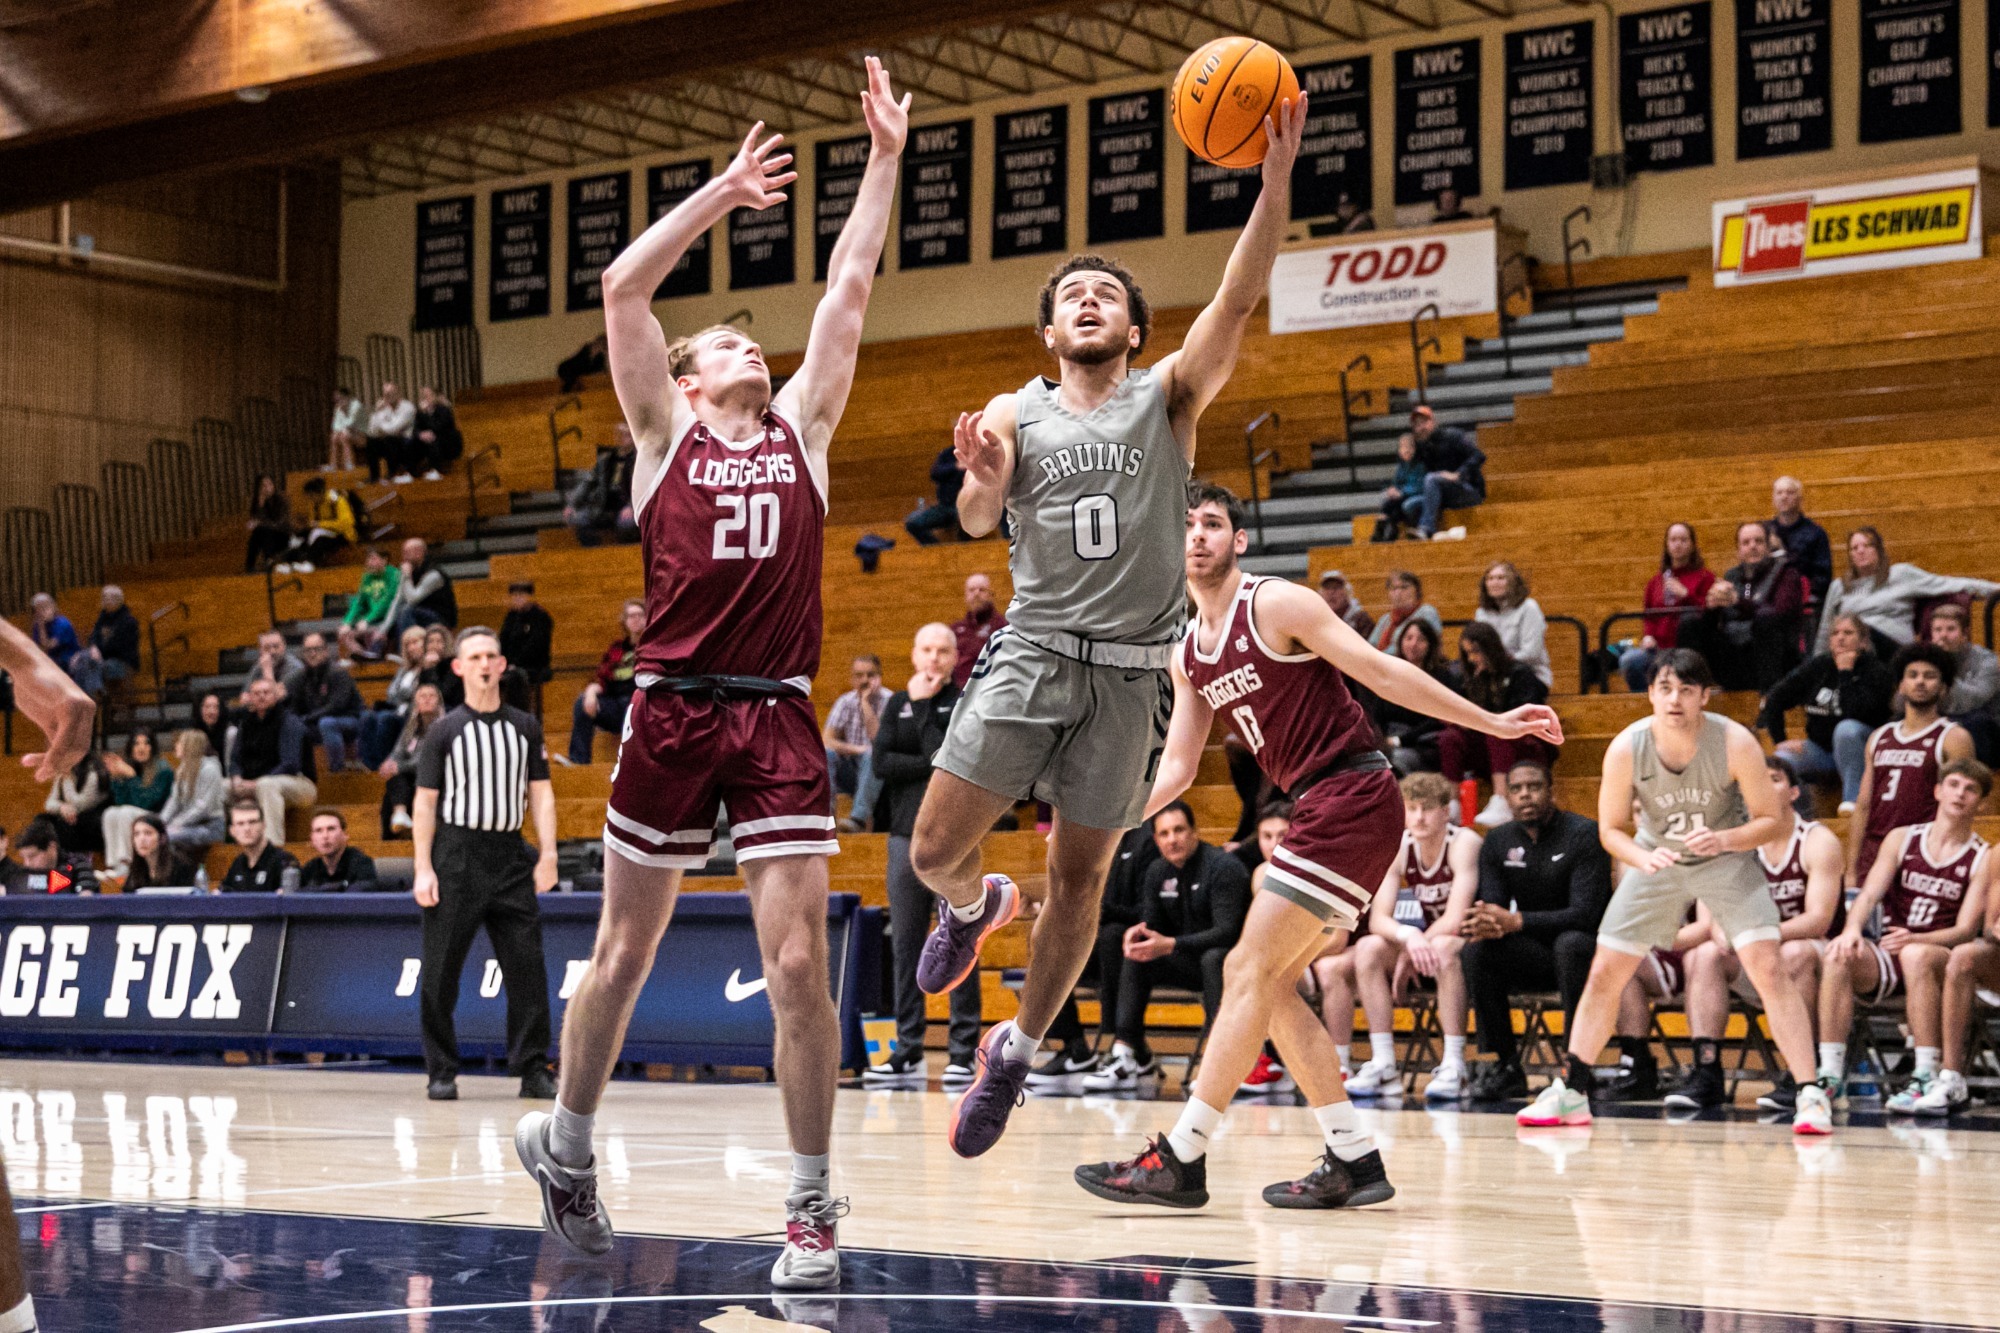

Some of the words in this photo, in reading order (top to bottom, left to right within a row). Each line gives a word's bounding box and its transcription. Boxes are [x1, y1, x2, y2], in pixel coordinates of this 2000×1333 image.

[1638, 11, 1693, 42] NWC
[1523, 29, 1576, 60] NWC
[1412, 47, 1463, 77] NWC
[1305, 65, 1355, 93] NWC
[1103, 95, 1150, 125] NWC
[916, 126, 958, 153] NWC
[1008, 113, 1053, 140] NWC
[1747, 212, 1805, 258] Tires
[1812, 217, 1850, 244] LES
[1856, 203, 1961, 239] SCHWAB
[1324, 242, 1447, 287] TODD
[1321, 285, 1419, 309] Construction
[688, 453, 797, 488] LOGGERS
[1038, 442, 1144, 485] BRUINS
[712, 492, 780, 560] 20
[1072, 492, 1119, 561] 0
[1198, 662, 1264, 711] OGGERS
[1873, 749, 1927, 768] LOGGERS
[1655, 787, 1713, 809] BRUINS
[1881, 768, 1902, 801] 3
[1664, 811, 1706, 840] 21
[1901, 869, 1963, 901] LOGGERS
[103, 924, 254, 1019] FOX
